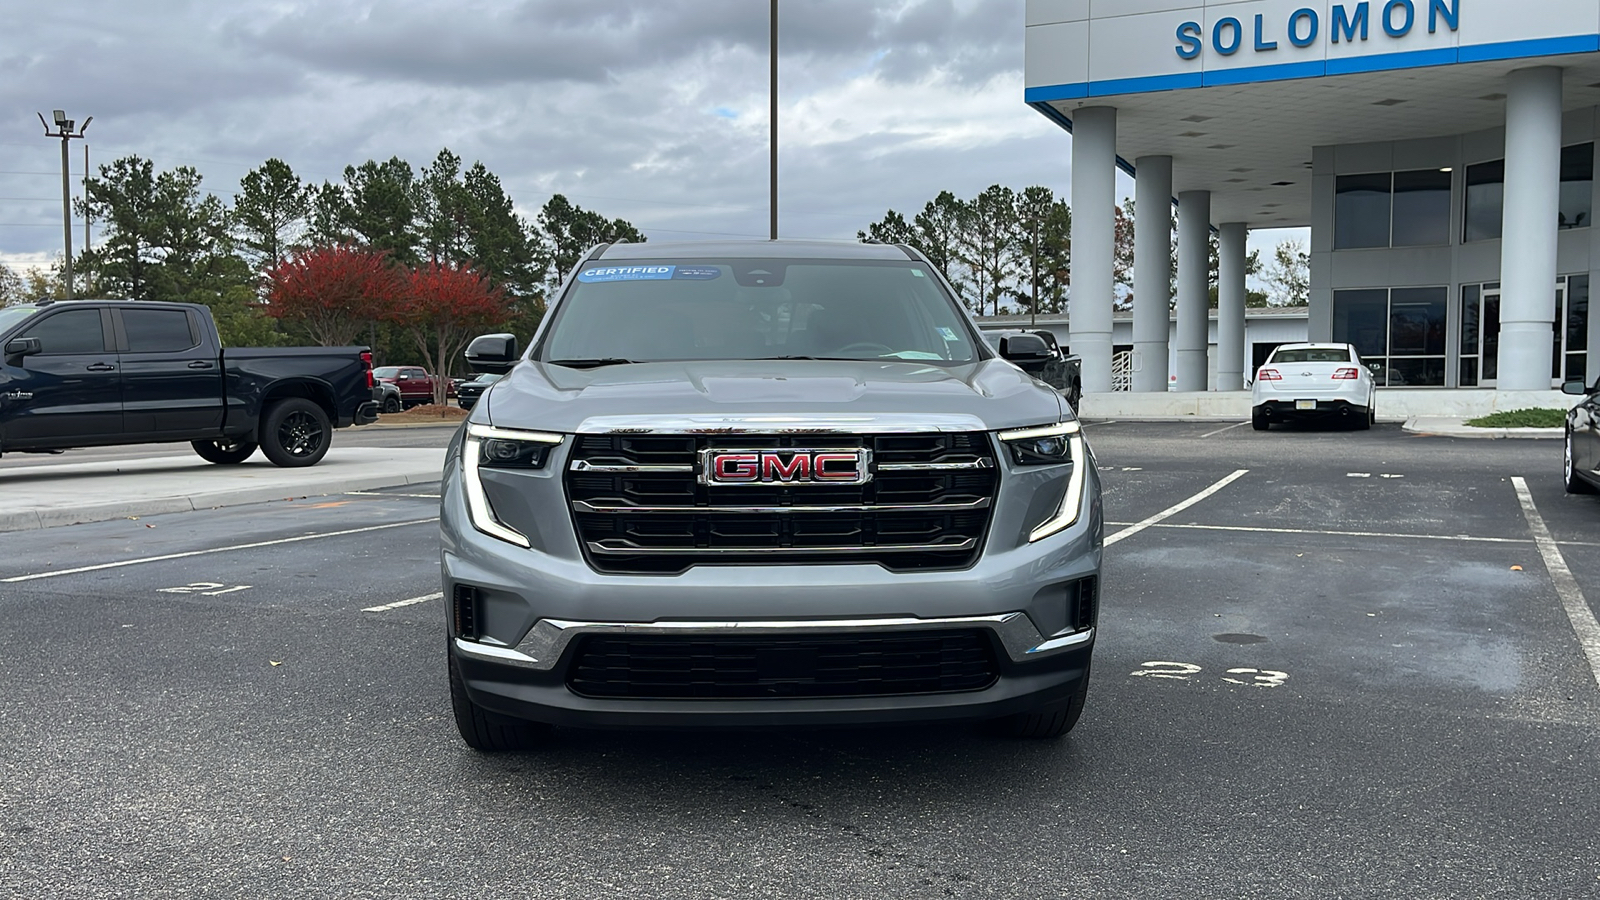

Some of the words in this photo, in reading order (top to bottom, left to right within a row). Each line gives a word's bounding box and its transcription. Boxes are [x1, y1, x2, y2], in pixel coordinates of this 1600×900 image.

[1175, 0, 1459, 60] SOLOMON
[584, 267, 669, 277] CERTIFIED
[714, 454, 860, 481] GMC
[1129, 661, 1290, 687] 23
